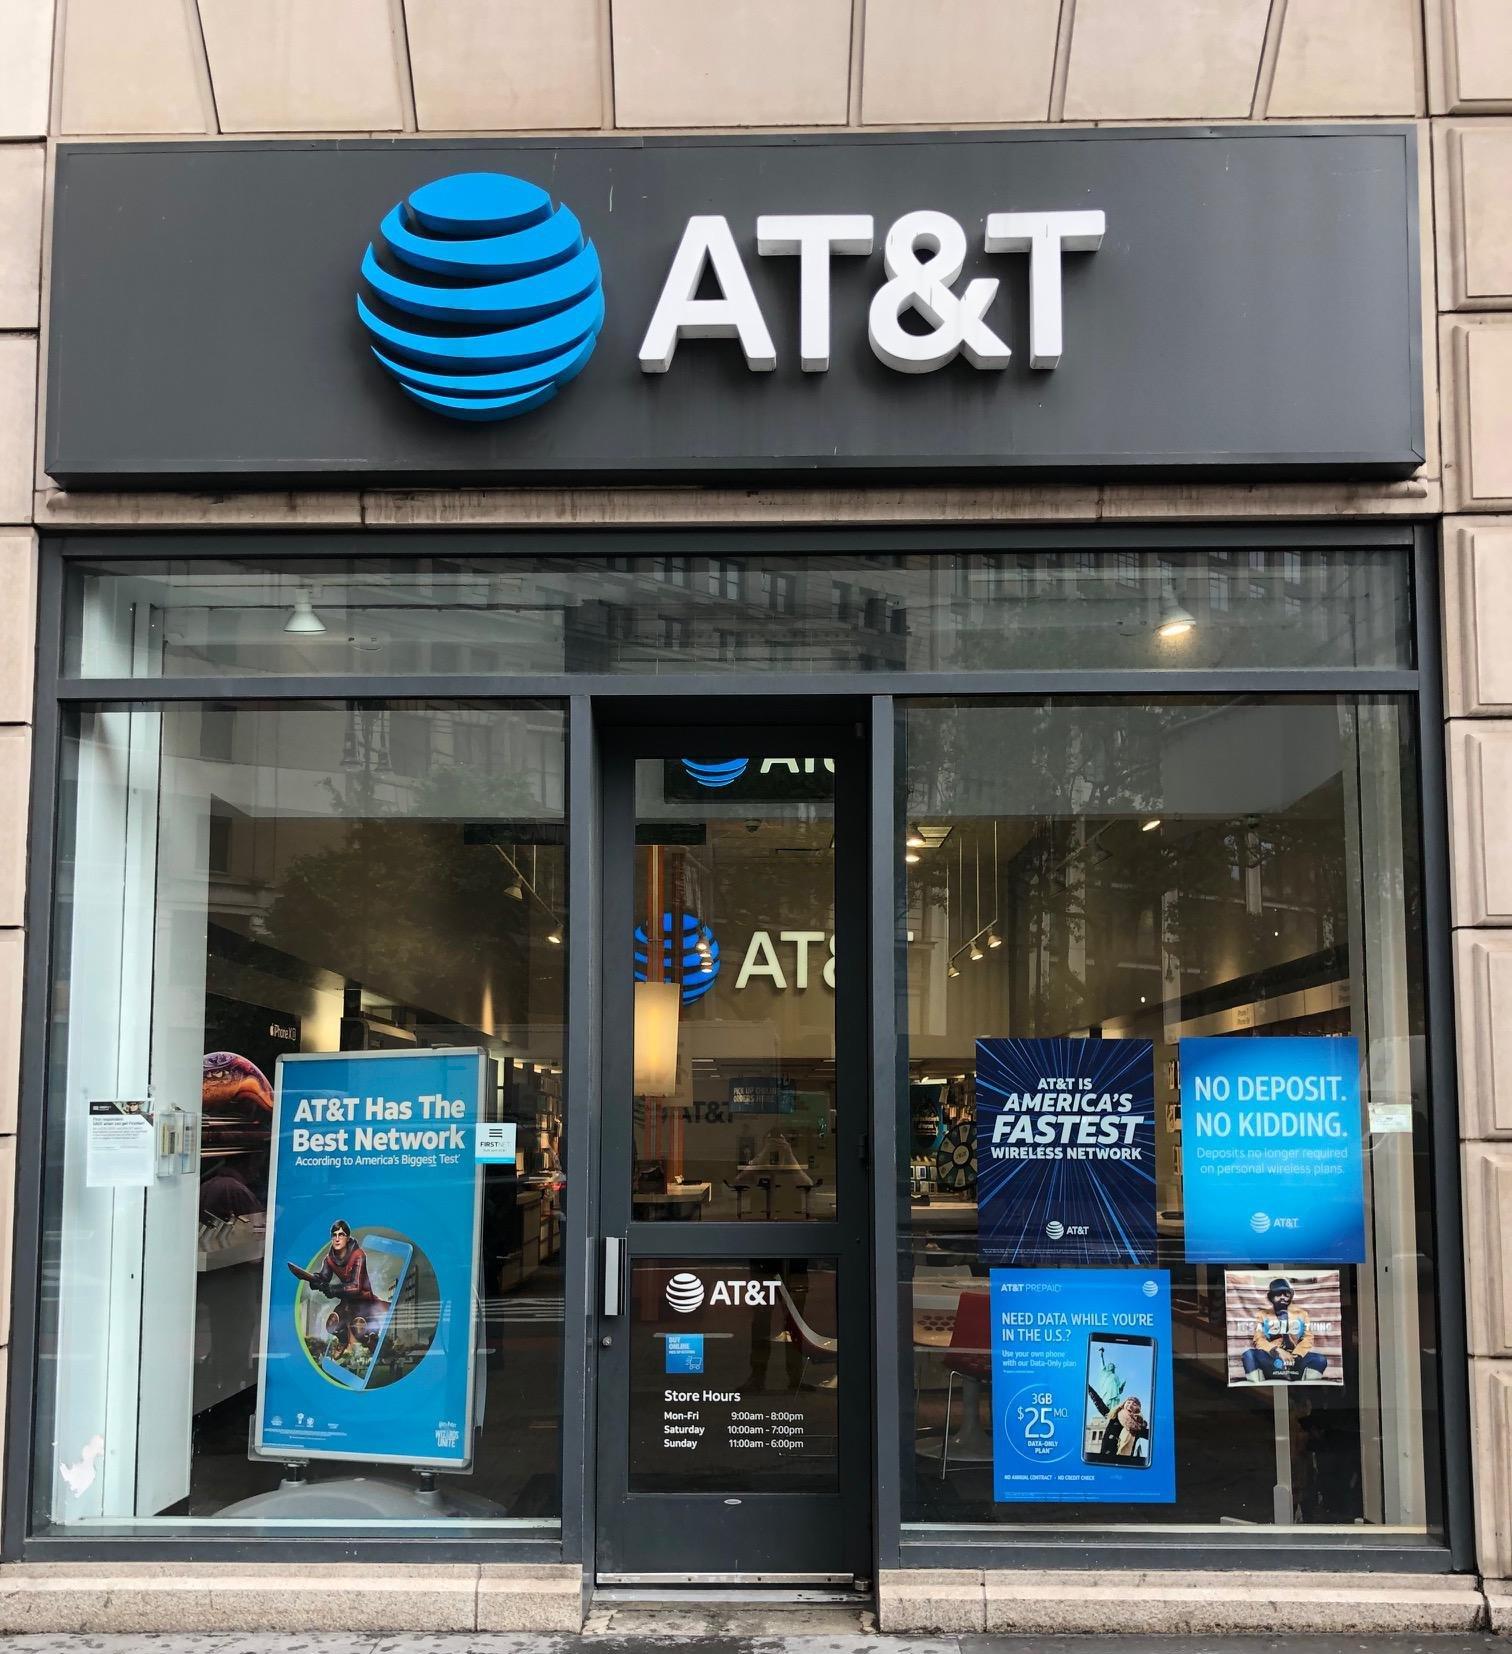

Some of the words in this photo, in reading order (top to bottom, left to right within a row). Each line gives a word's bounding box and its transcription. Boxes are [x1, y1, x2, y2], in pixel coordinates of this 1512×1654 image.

[638, 209, 1106, 373] AT&T
[735, 931, 836, 990] AT
[1037, 1077, 1075, 1090] AT&T
[1078, 1077, 1093, 1090] IS
[1195, 1075, 1230, 1101] NO
[1237, 1075, 1347, 1101] DEPOSIT.
[293, 1097, 360, 1122] AT&T
[365, 1096, 413, 1121] Has
[418, 1093, 466, 1119] The
[1003, 1093, 1133, 1112] AMERICA'S
[991, 1114, 1145, 1144] FASTEST
[1196, 1112, 1231, 1137] NO
[1239, 1112, 1348, 1137] KIDDING.
[292, 1128, 349, 1152] Best
[354, 1124, 466, 1150] Network
[990, 1147, 1063, 1160] WIRELESS
[1066, 1147, 1142, 1160] NETWORK
[1196, 1147, 1246, 1161] Deposits
[1247, 1149, 1262, 1159] no
[1264, 1147, 1298, 1161] longer
[1302, 1147, 1348, 1161] required
[295, 1154, 341, 1168] According
[342, 1156, 353, 1166] to
[355, 1154, 400, 1166] America's
[401, 1153, 437, 1168] Biggest
[1200, 1165, 1214, 1174] on
[1217, 1164, 1265, 1176] personal
[1267, 1164, 1311, 1174] wireless
[1313, 1164, 1345, 1176] plans.
[1273, 1218, 1299, 1228] AT&T
[1066, 1226, 1090, 1235] AT&T
[709, 1280, 782, 1306] AT&T
[1001, 1284, 1025, 1292] AT&T
[1025, 1284, 1061, 1292] PREPAID
[1002, 1312, 1034, 1326] NEED
[1037, 1312, 1068, 1326] DATA
[1071, 1313, 1108, 1326] WHILE
[1112, 1313, 1154, 1327] YOU'RE
[1002, 1328, 1014, 1342] IN
[1017, 1328, 1041, 1342] THE
[1044, 1329, 1072, 1342] U.S.?
[1002, 1350, 1014, 1358] Use
[1015, 1351, 1029, 1360] your
[1045, 1350, 1066, 1360] phone
[1002, 1359, 1017, 1367] with
[1030, 1360, 1062, 1369] Data-Only
[1063, 1361, 1077, 1369] plan
[664, 1390, 700, 1402] Store
[703, 1390, 741, 1402] Hours
[1031, 1392, 1053, 1405] 3GB
[664, 1411, 699, 1421] Mon-Fri
[731, 1411, 764, 1421] 9:00am
[770, 1411, 804, 1422] 8:00pm
[664, 1425, 706, 1436] Saturday
[727, 1425, 764, 1434] 10:00am
[771, 1425, 804, 1436] 7:00pm
[664, 1438, 698, 1450] Sunday
[728, 1439, 764, 1448] 11:00am
[770, 1439, 804, 1450] 6:00pm
